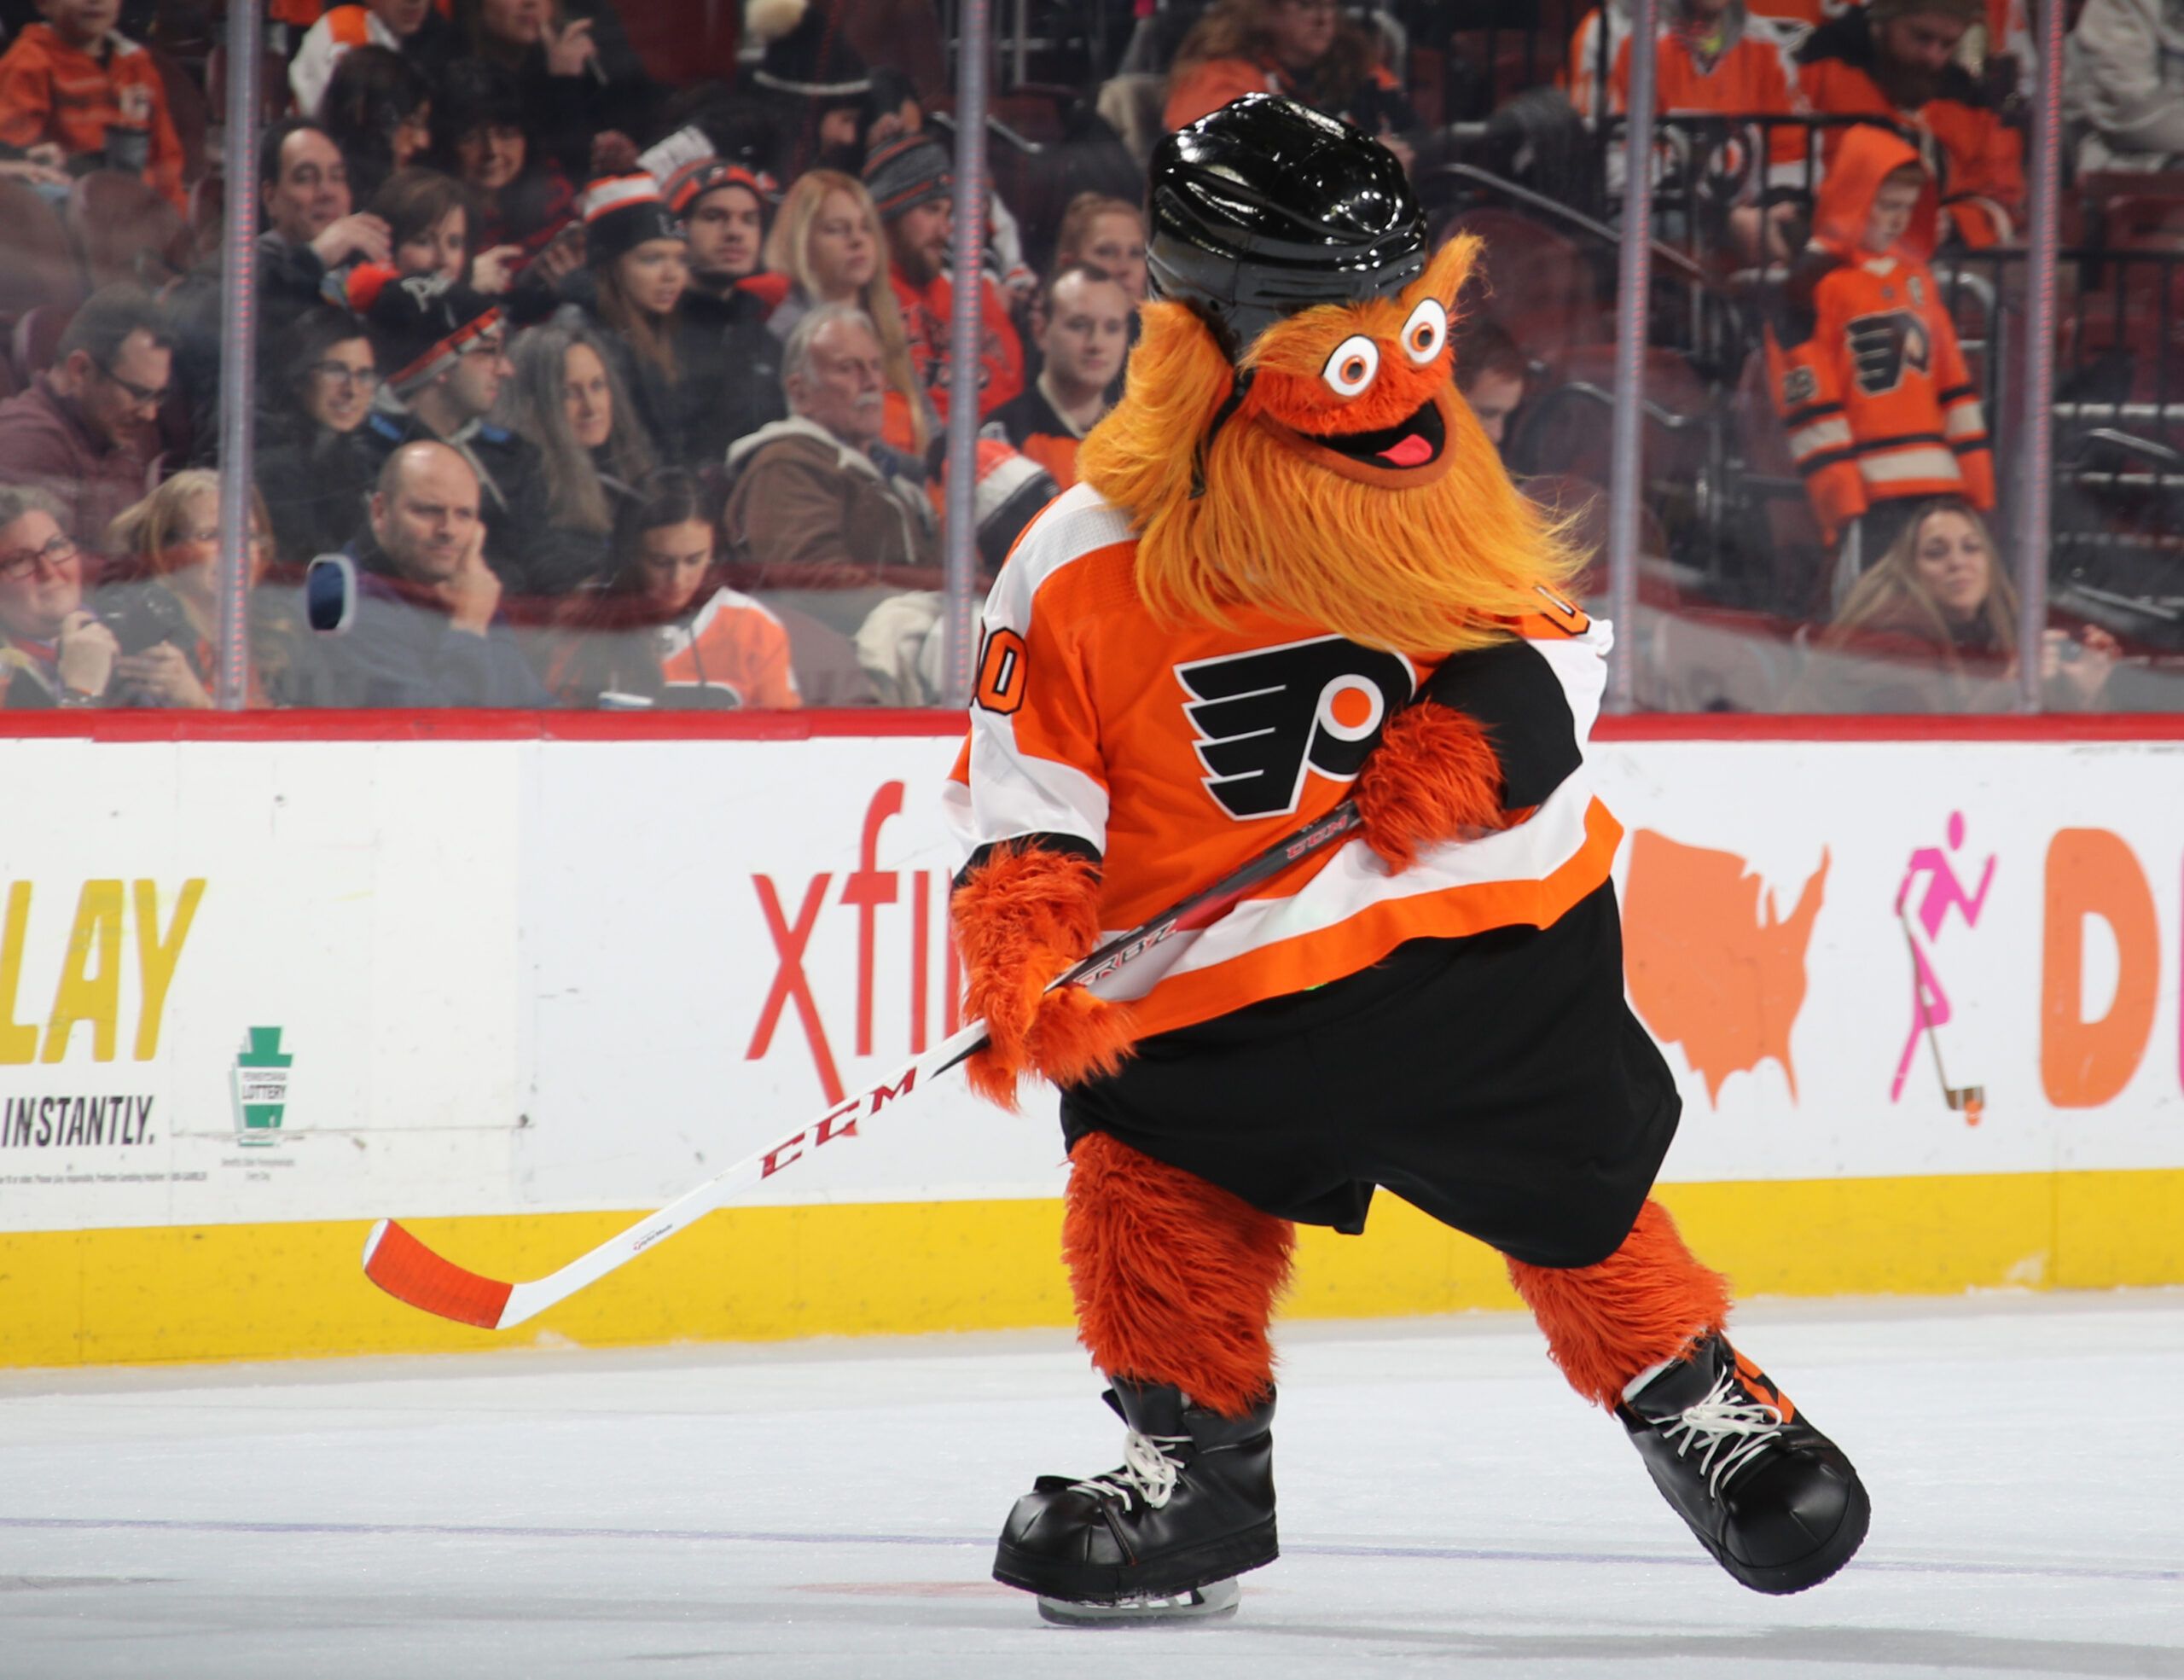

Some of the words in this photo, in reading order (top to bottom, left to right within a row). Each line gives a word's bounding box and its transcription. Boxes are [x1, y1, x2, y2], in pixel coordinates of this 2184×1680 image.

[970, 617, 1029, 716] 0
[1286, 814, 1348, 860] CCM
[0, 878, 207, 1065] LAY
[2039, 827, 2184, 1108] D
[1, 1096, 154, 1148] INSTANTLY.
[759, 1067, 917, 1180] CCM
